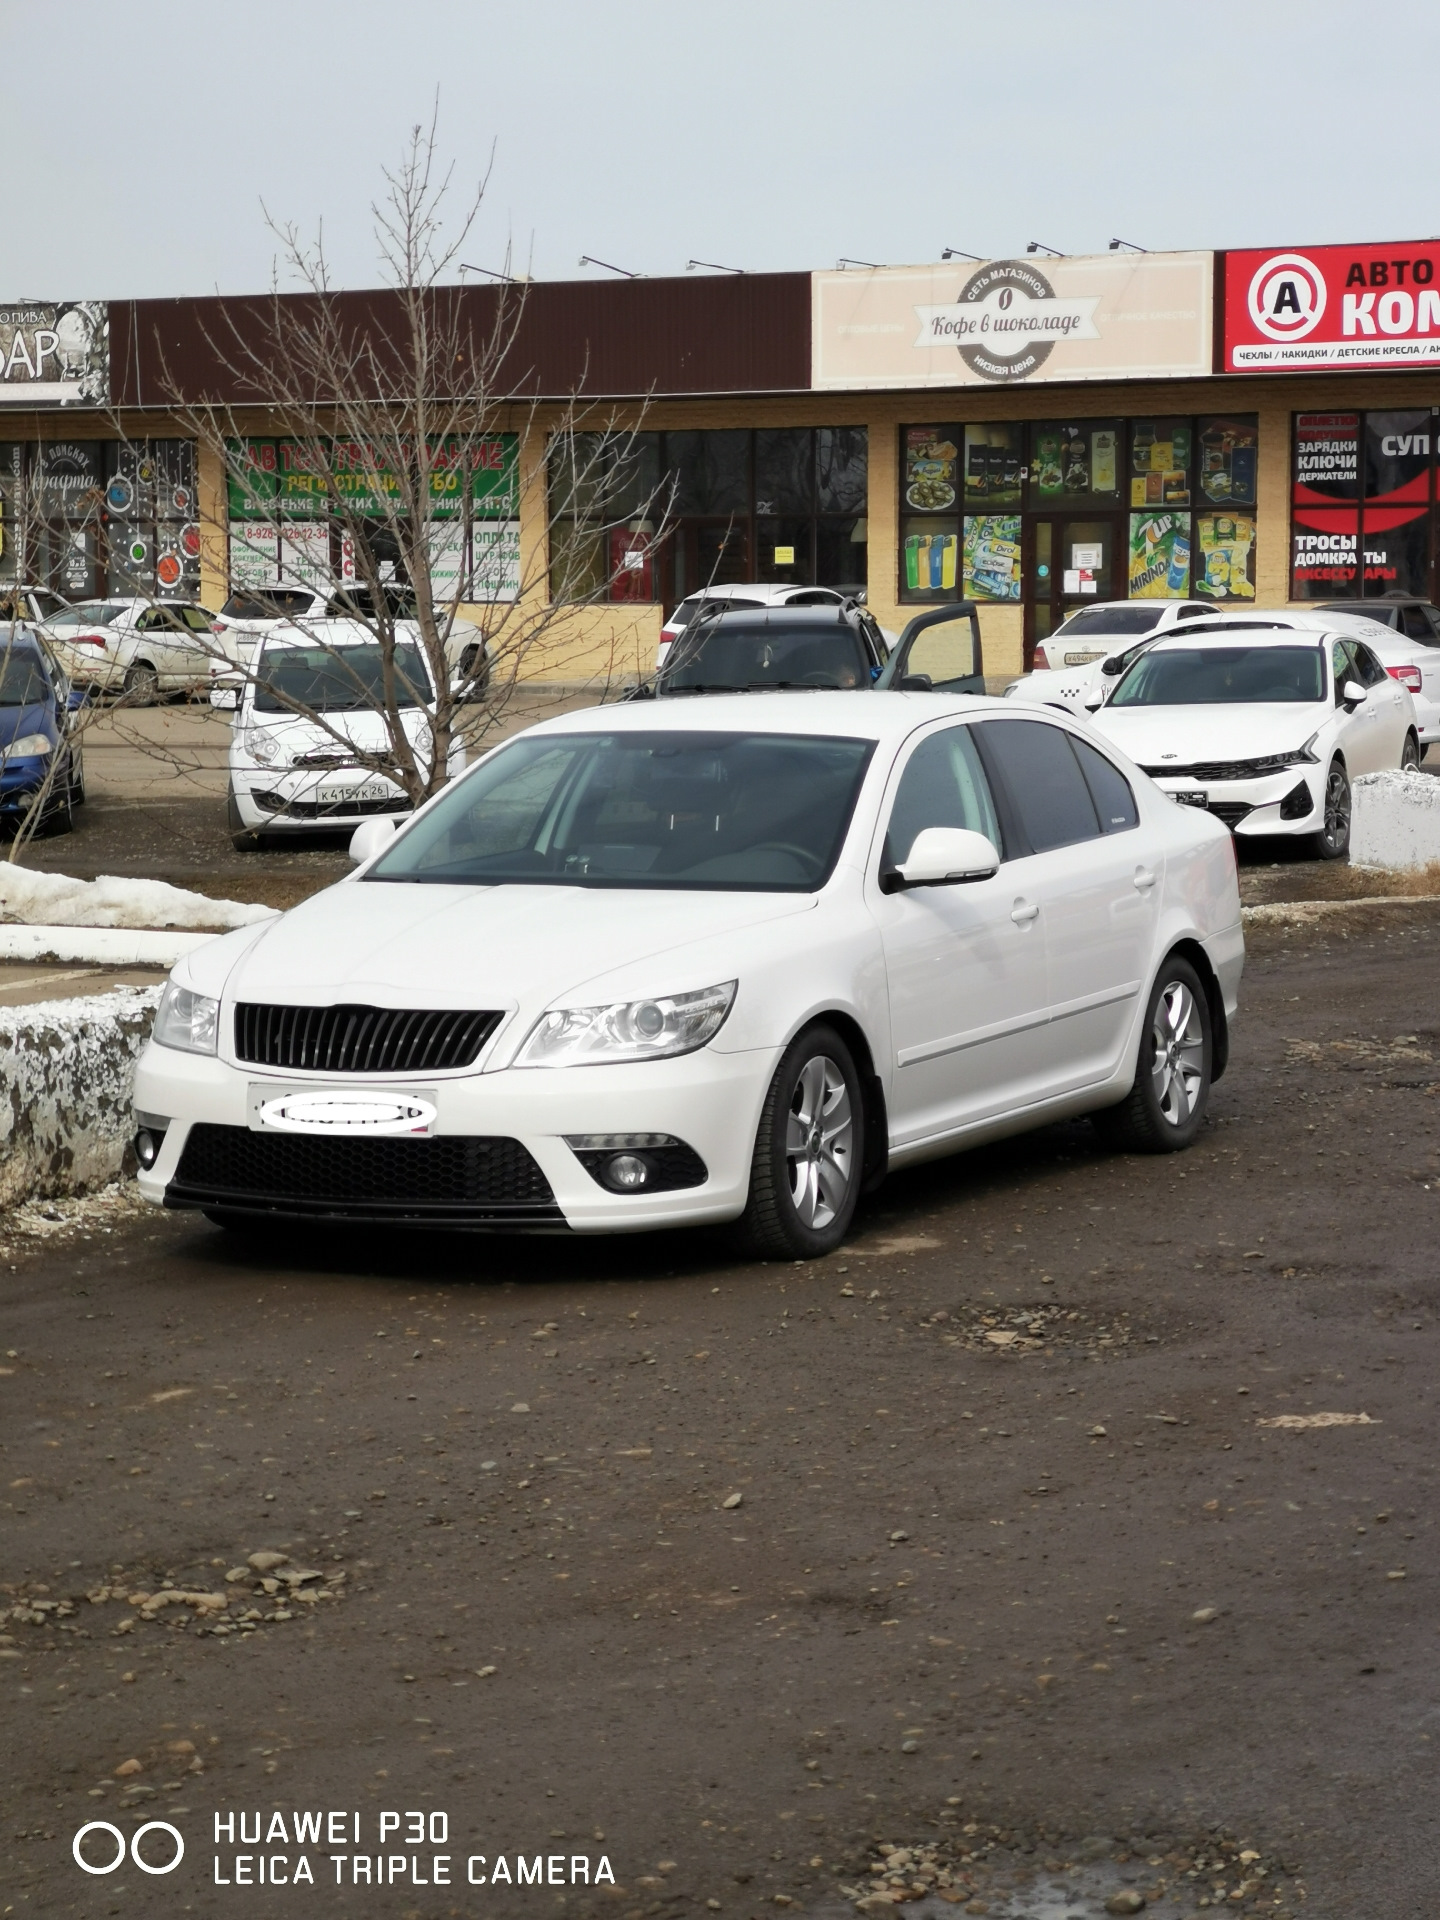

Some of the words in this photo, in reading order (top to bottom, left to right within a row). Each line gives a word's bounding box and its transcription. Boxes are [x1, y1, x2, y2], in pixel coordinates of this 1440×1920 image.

[1345, 259, 1434, 287] АВТО
[967, 277, 990, 300] СЕТЬ
[990, 268, 1046, 298] МАГАЗИНОВ
[12, 311, 47, 323] ПИВА
[931, 316, 977, 340] Кофе
[980, 313, 990, 332] в
[993, 315, 1081, 335] шоколаде
[0, 329, 60, 379] АР
[1239, 351, 1272, 360] ЧЕХЛЫ
[1281, 350, 1328, 359] НАКИДКИ
[1337, 347, 1380, 359] ДЕТСКИЕ
[1383, 346, 1420, 355] КРЕСЛА
[973, 355, 1008, 374] низкая
[1010, 355, 1036, 374] цена
[1298, 441, 1357, 453] ЗАРЯДКИ
[1381, 434, 1440, 456] СУП
[1298, 456, 1357, 469] КЛЮЧИ
[287, 474, 410, 492] РЕГИСТРАЦИ
[1298, 471, 1357, 482] ДЕРЖАТЕЛИ
[232, 545, 276, 553] ОФОРЕНИЕ
[1295, 536, 1357, 550] ТРОСЫ
